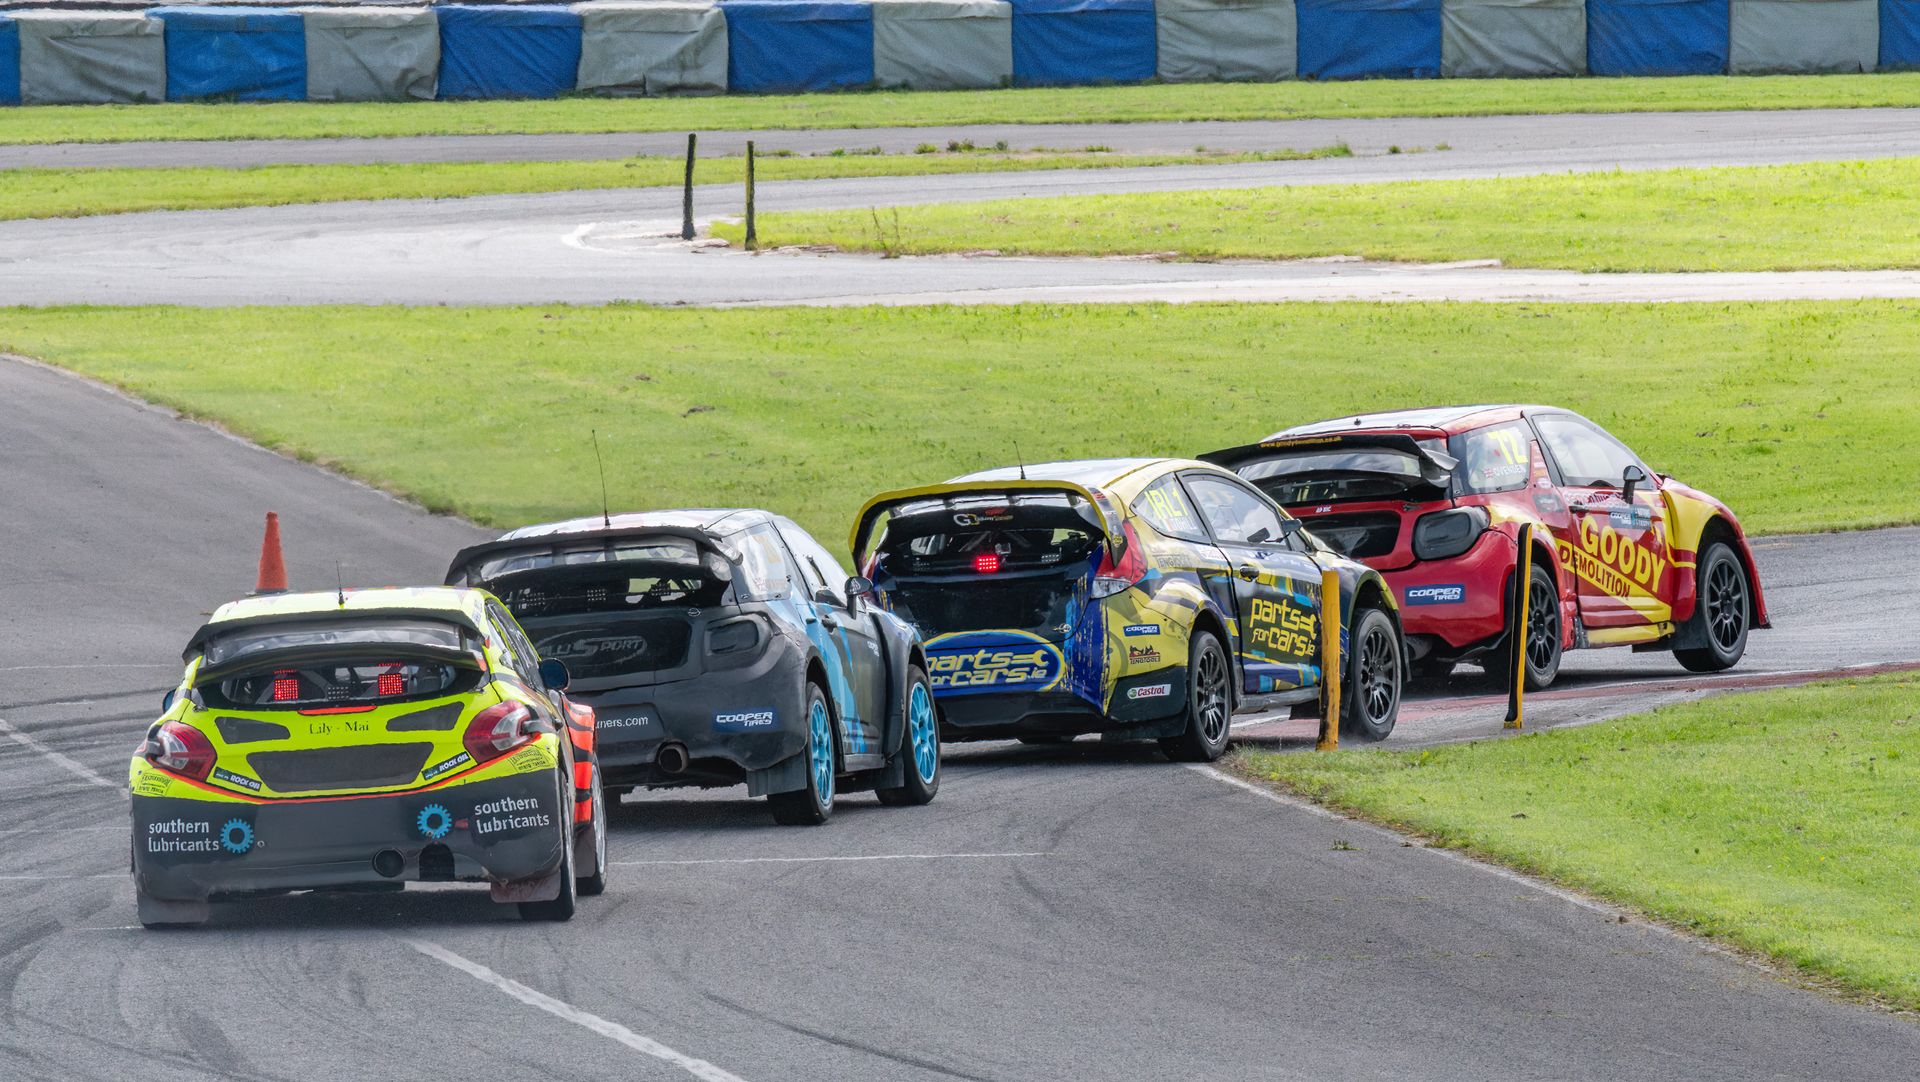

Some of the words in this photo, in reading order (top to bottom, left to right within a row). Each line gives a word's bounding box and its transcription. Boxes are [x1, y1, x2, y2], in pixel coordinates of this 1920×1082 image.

[1487, 429, 1528, 465] 72
[1581, 515, 1665, 593] GOODY
[1560, 544, 1630, 598] DEMOLITION
[1409, 587, 1461, 597] COOPER
[1249, 598, 1301, 630] parts
[1137, 686, 1165, 697] Castrol
[716, 711, 773, 723] COOPER
[309, 723, 333, 735] Lily
[345, 720, 369, 731] Mai
[474, 796, 538, 815] southern
[149, 818, 209, 834] southern
[476, 813, 550, 834] lubricants
[148, 837, 219, 852] lubricants
